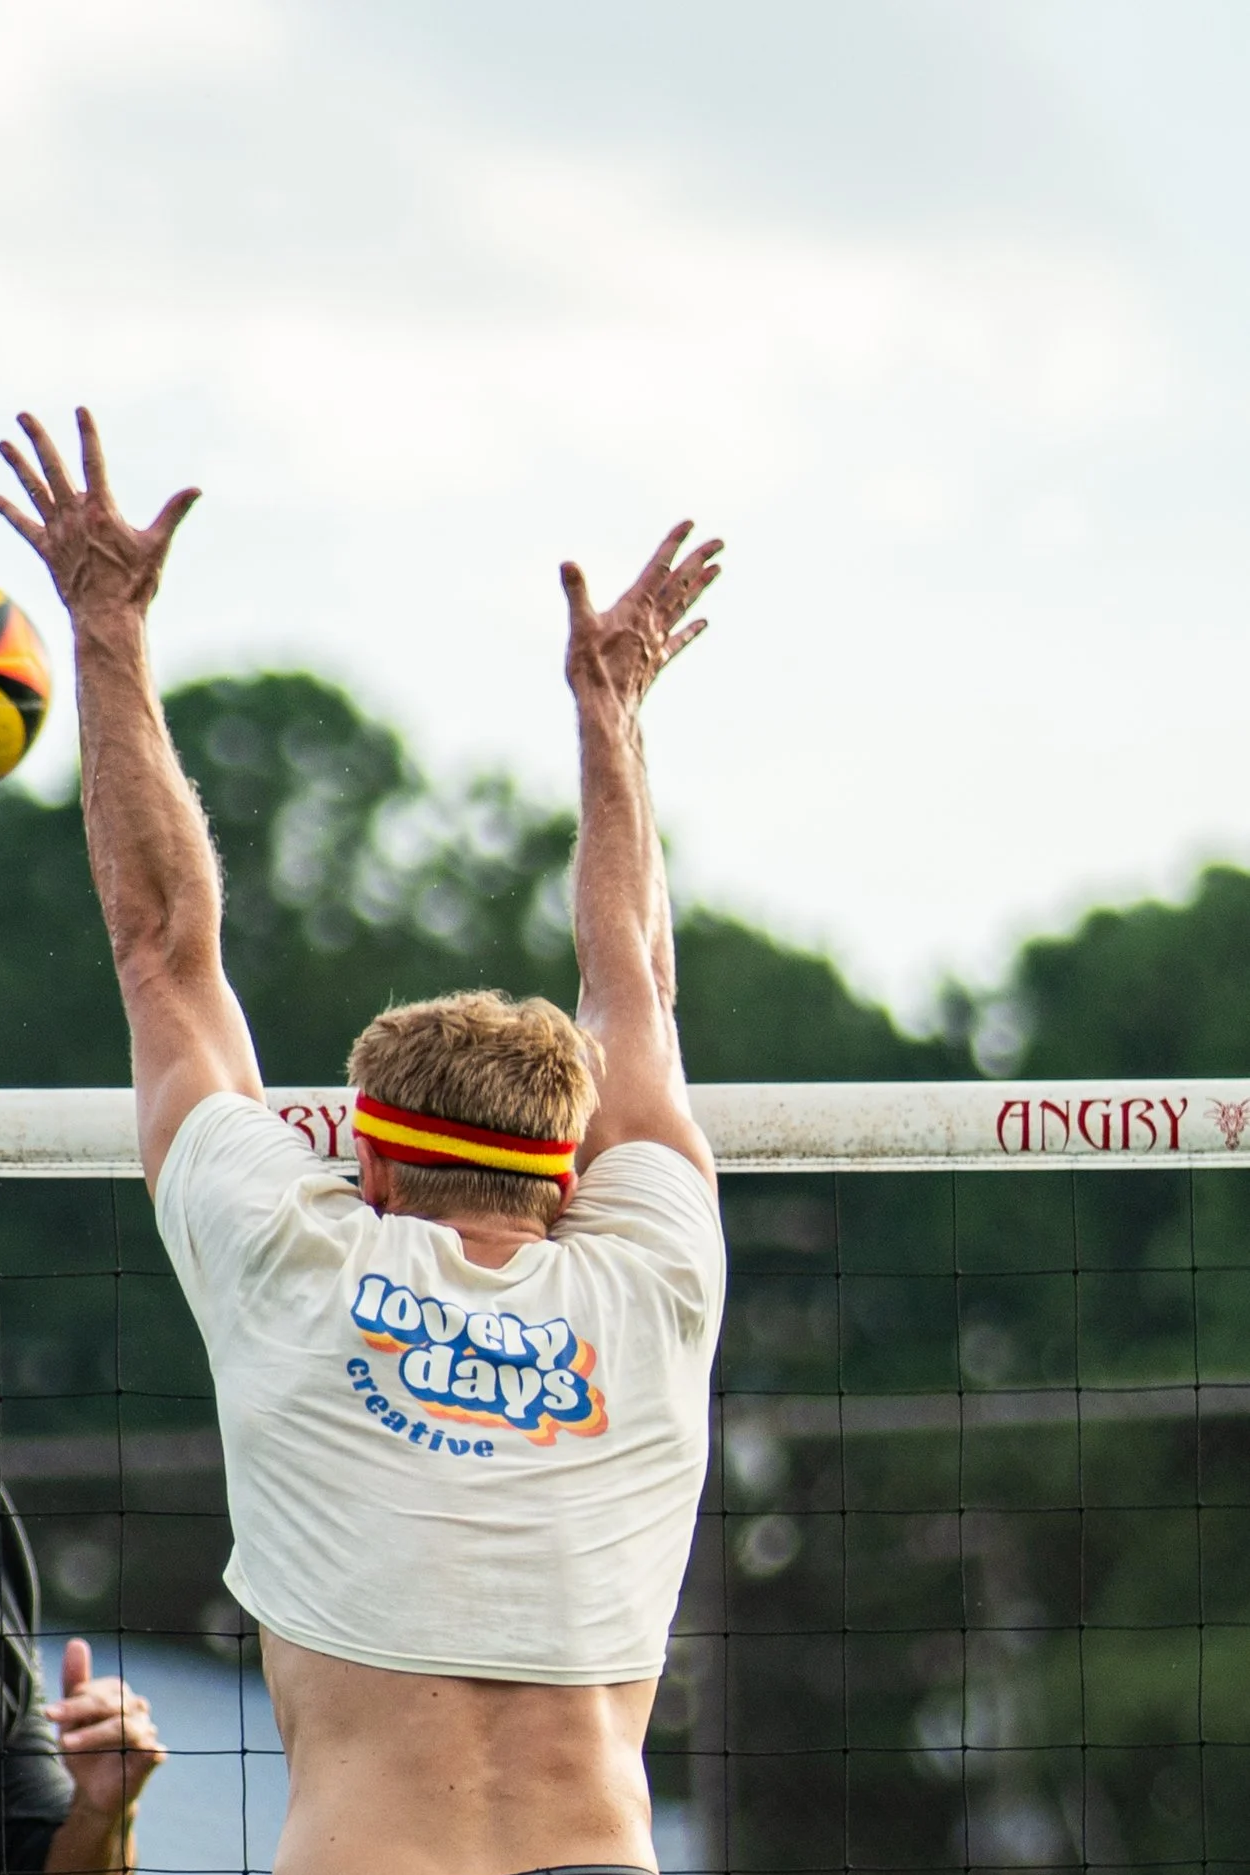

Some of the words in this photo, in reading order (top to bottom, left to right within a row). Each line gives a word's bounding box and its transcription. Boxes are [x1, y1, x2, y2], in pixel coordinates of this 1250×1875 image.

[996, 1097, 1189, 1153] ANGRY
[353, 1275, 570, 1370] lovely
[346, 1357, 495, 1458] creative
[403, 1344, 579, 1419] days
